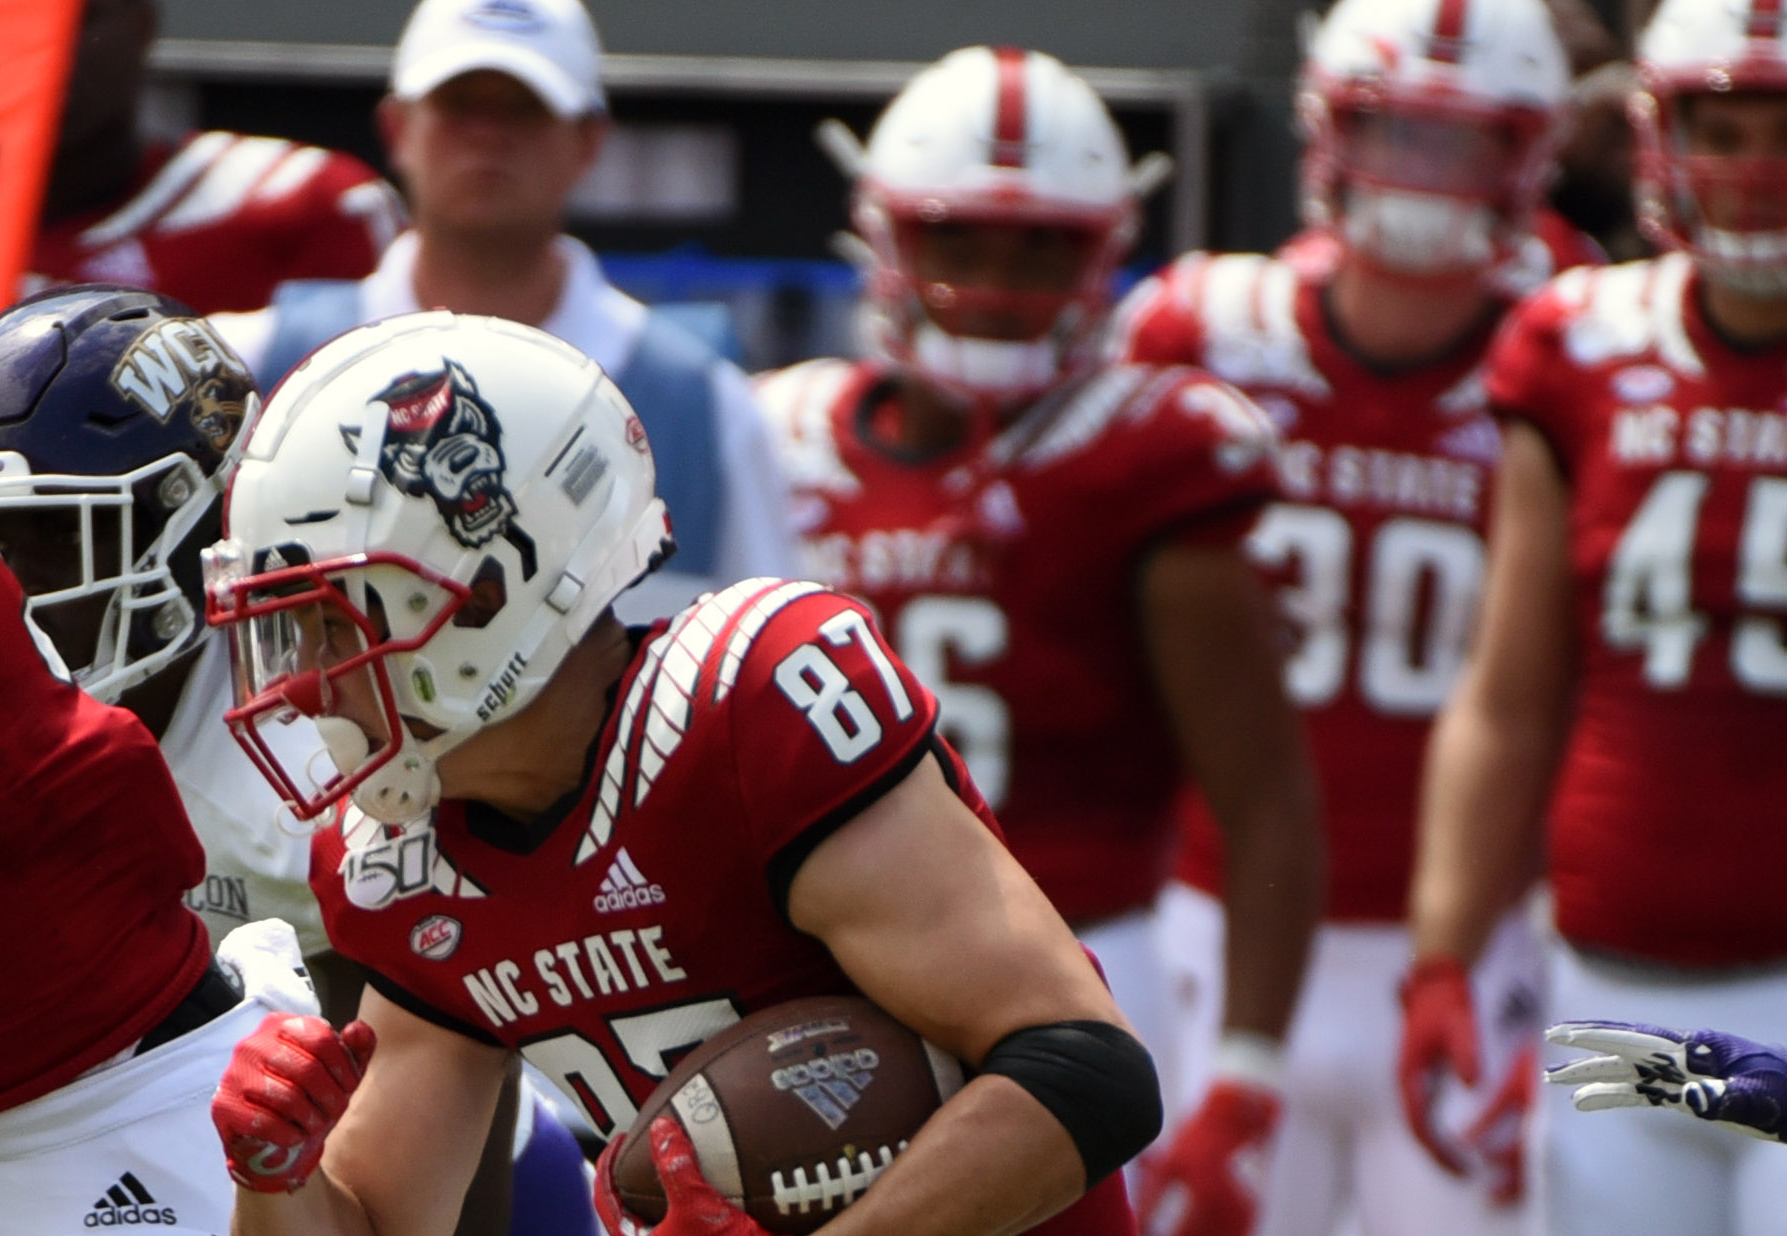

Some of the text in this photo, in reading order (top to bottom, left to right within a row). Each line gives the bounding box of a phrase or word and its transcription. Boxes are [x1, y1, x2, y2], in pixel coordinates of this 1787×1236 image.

[1244, 500, 1490, 716] 30
[476, 650, 528, 722] schutt
[774, 608, 913, 765] 87
[872, 596, 1012, 813] 6
[418, 919, 452, 951] ACC
[593, 883, 667, 914] adidas
[463, 925, 687, 1028] NC STATE
[83, 1203, 178, 1228] adidas
